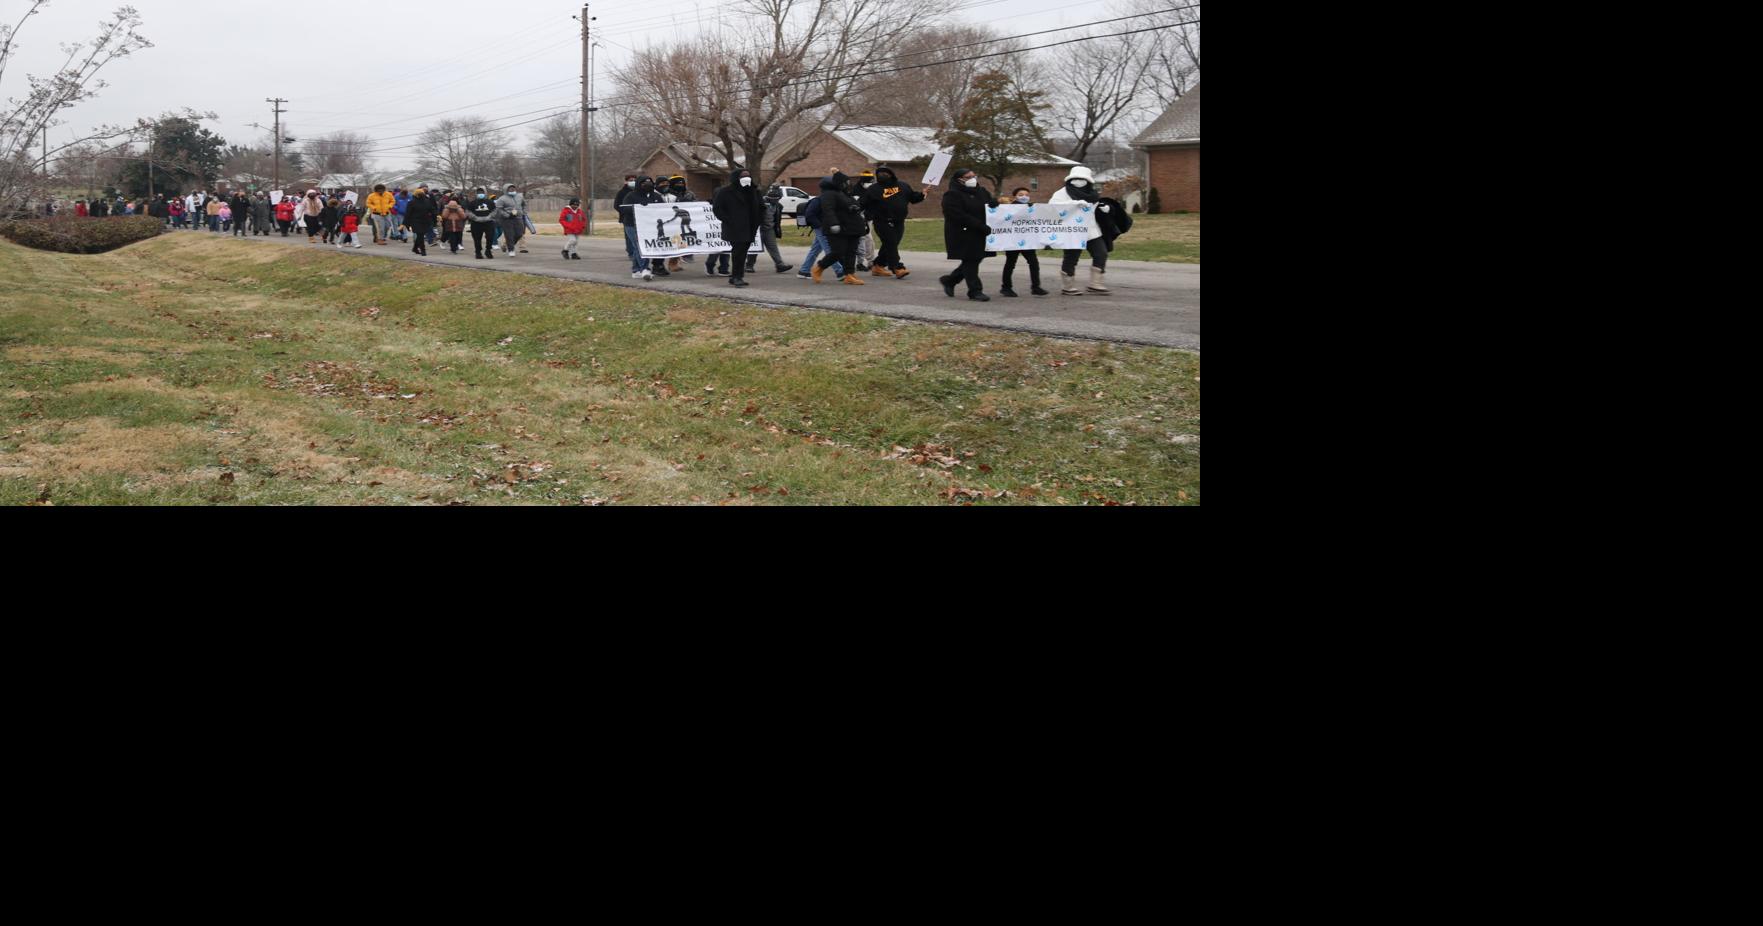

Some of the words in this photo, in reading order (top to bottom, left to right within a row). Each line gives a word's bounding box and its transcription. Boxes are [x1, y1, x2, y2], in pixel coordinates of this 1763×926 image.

[992, 227, 1012, 235] UMAN
[1014, 226, 1039, 234] RIGHTS
[644, 239, 673, 249] Men
[687, 236, 702, 246] Be
